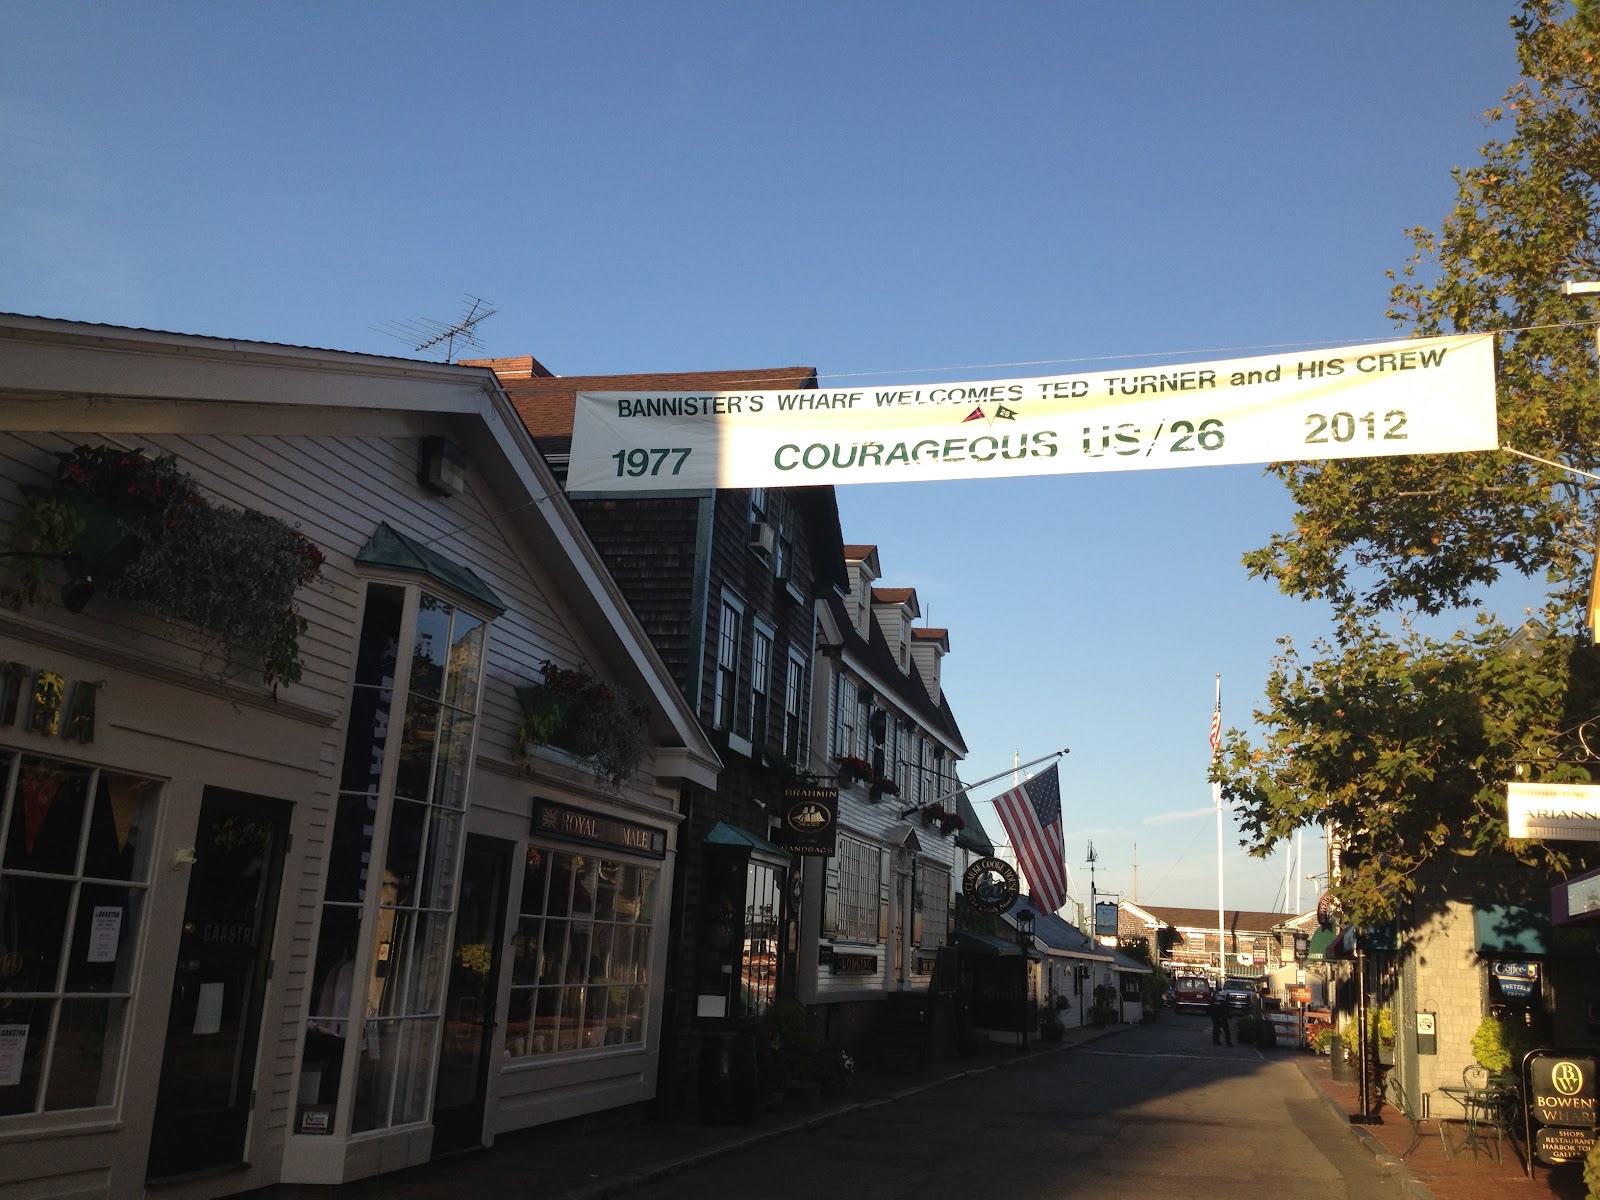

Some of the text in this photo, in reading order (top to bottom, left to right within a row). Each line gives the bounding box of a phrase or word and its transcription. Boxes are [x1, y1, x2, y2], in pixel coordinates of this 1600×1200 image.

[618, 348, 1447, 418] BANNISTER'S WHARF WELCOMES TED TURNER and HIS CREW
[1305, 409, 1408, 444] 2012
[612, 447, 692, 478] 1977
[774, 430, 1058, 471] COURAGEOUS
[785, 789, 837, 798] BRAHMIN
[561, 812, 648, 848] ROYAL MALE
[965, 860, 1016, 892] CLARKE COOKE HOUSE
[1495, 963, 1526, 976] Coffee
[1538, 1096, 1599, 1109] BOWEN'
[1542, 1143, 1576, 1152] HARBOR
[1558, 1130, 1585, 1138] SHOPS
